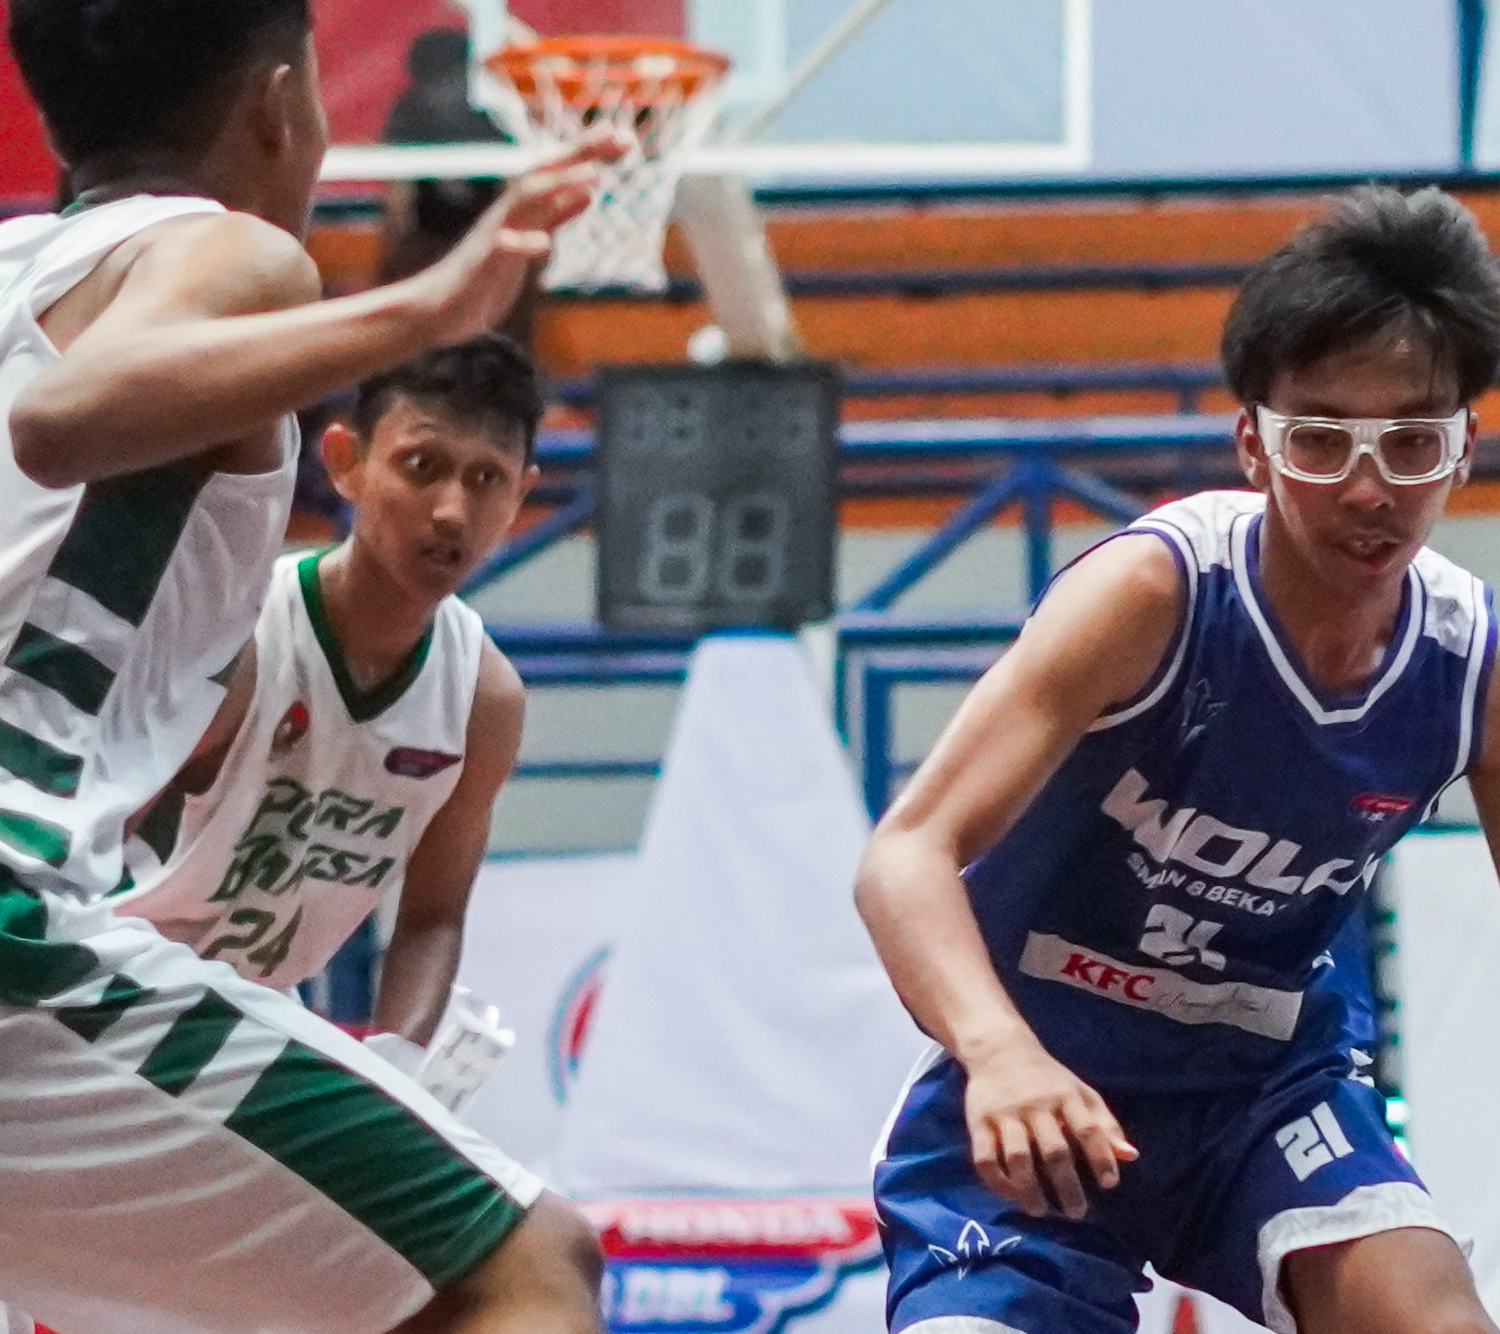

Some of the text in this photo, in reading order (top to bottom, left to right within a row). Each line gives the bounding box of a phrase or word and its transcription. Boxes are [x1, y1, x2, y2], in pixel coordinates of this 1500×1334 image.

[200, 905, 302, 978] 24
[1059, 951, 1156, 1003] KFC
[1274, 1100, 1355, 1183] 21
